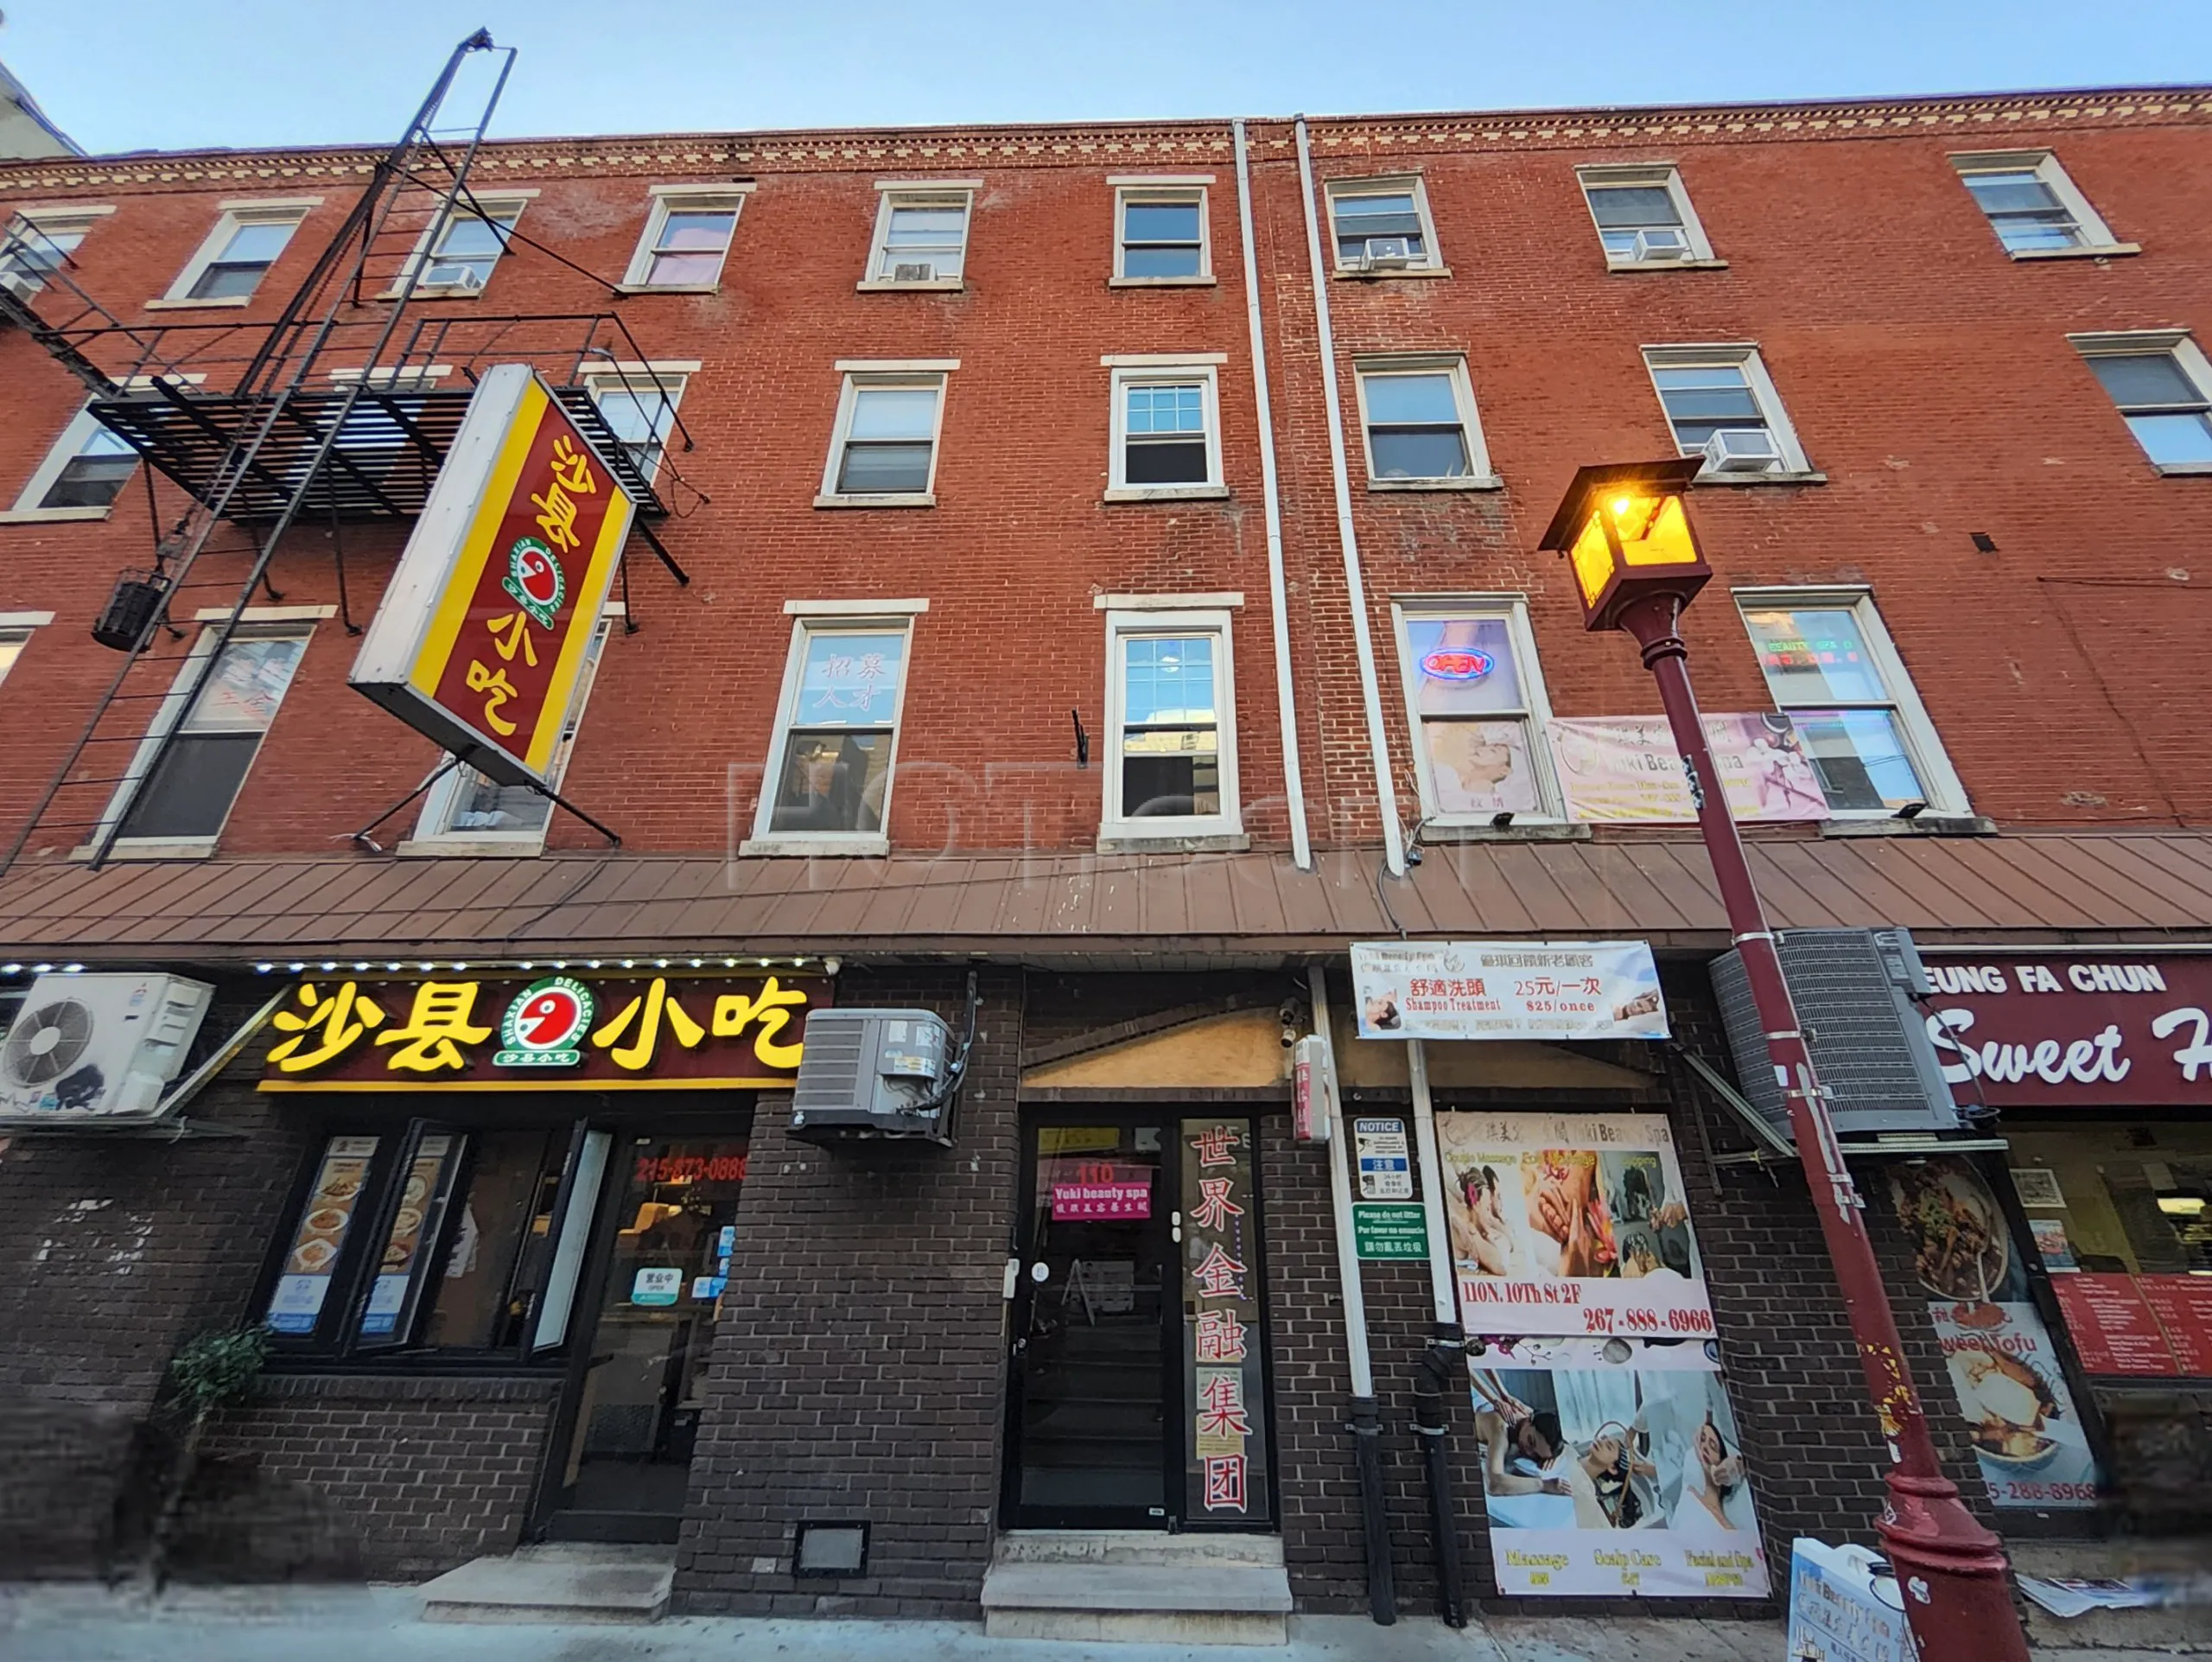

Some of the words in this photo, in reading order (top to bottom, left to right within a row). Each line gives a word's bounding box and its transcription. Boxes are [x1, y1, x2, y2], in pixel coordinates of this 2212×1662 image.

[531, 435, 597, 553] 沙县
[466, 611, 538, 736] 小吃
[820, 653, 887, 680] 招募
[1425, 655, 1486, 674] OPEN
[812, 685, 883, 711] 人才
[1408, 977, 1486, 997] 舒適洗頭
[2015, 965, 2063, 992] FA
[2069, 964, 2167, 992] CHUN
[502, 988, 531, 1045] SHAXIAN
[554, 976, 593, 1042] DELICACIES
[1405, 997, 1448, 1014] Shampoo
[1449, 997, 1502, 1012] Treatment
[266, 979, 493, 1073] 沙县
[594, 976, 809, 1070] 小吃
[1925, 1009, 2131, 1084] Sweet
[1358, 1122, 1400, 1132] NOTICE
[1078, 1162, 1114, 1185] 110
[1372, 1159, 1395, 1171] 注意
[1054, 1187, 1082, 1200] Yuki
[1082, 1187, 1124, 1202] beauty
[1125, 1188, 1148, 1201] spa
[1560, 1283, 1581, 1304] 2F
[1190, 1126, 1253, 1514] 世界金融集团
